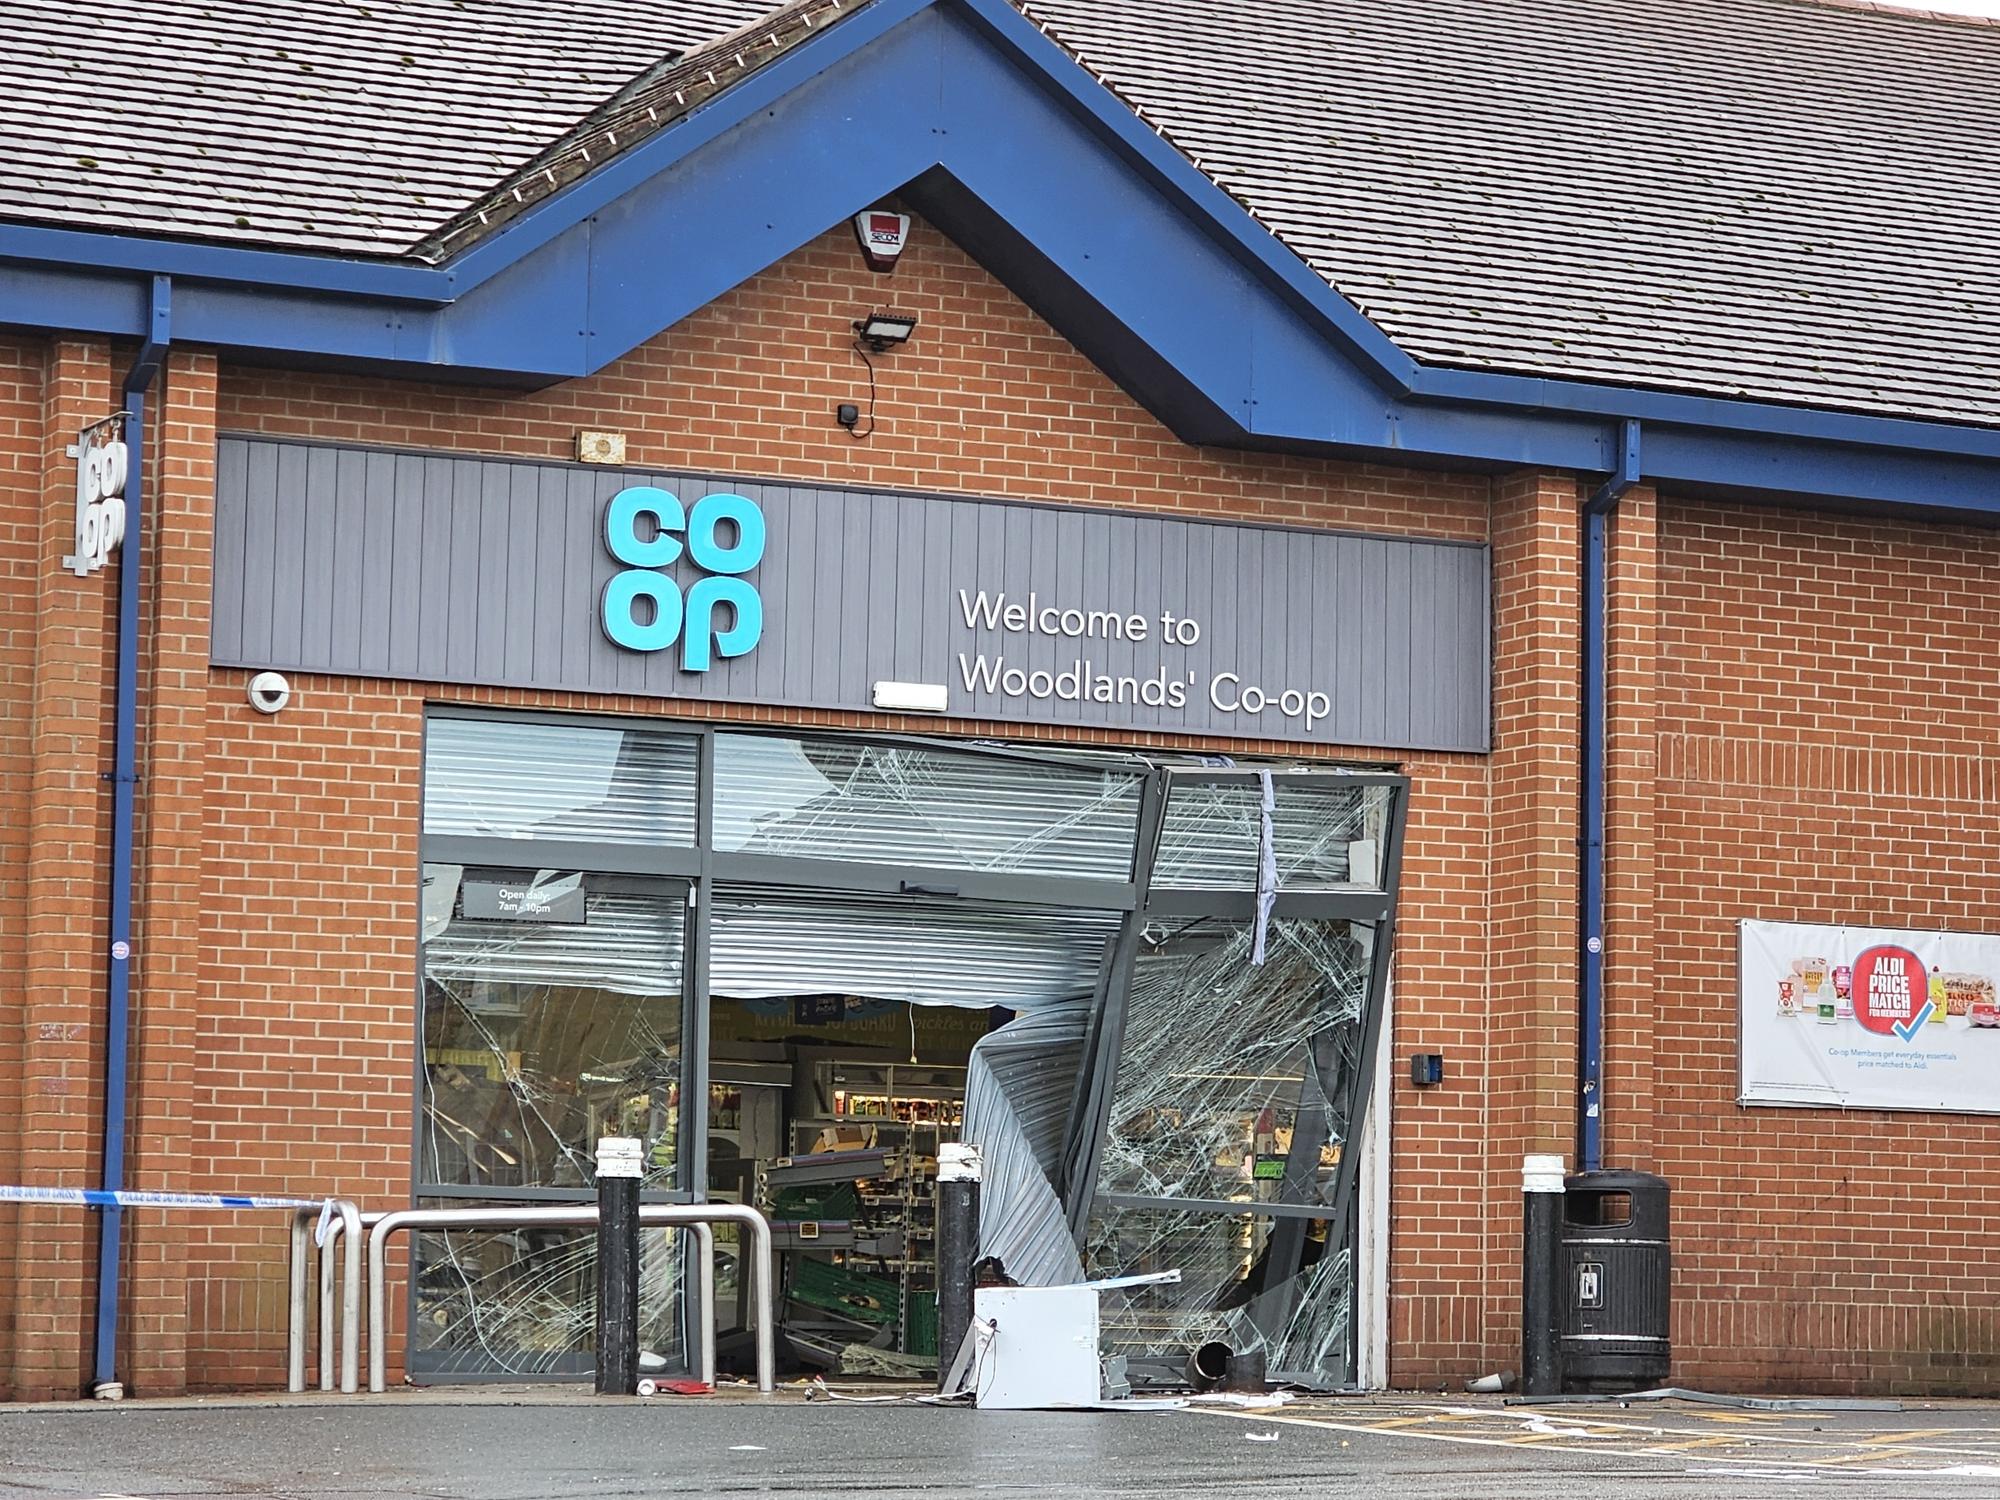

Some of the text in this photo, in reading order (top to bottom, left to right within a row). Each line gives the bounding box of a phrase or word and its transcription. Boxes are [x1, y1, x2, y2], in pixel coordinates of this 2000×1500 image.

[959, 588, 1201, 646] Welcome to
[958, 652, 1331, 732] Woodlands' Co-op
[499, 889, 525, 901] Open
[498, 901, 518, 911] 7am
[525, 902, 551, 915] 10pm
[1873, 957, 1905, 976] ALDI
[1869, 975, 1910, 994] PRICE
[1869, 993, 1911, 1010] MATCH
